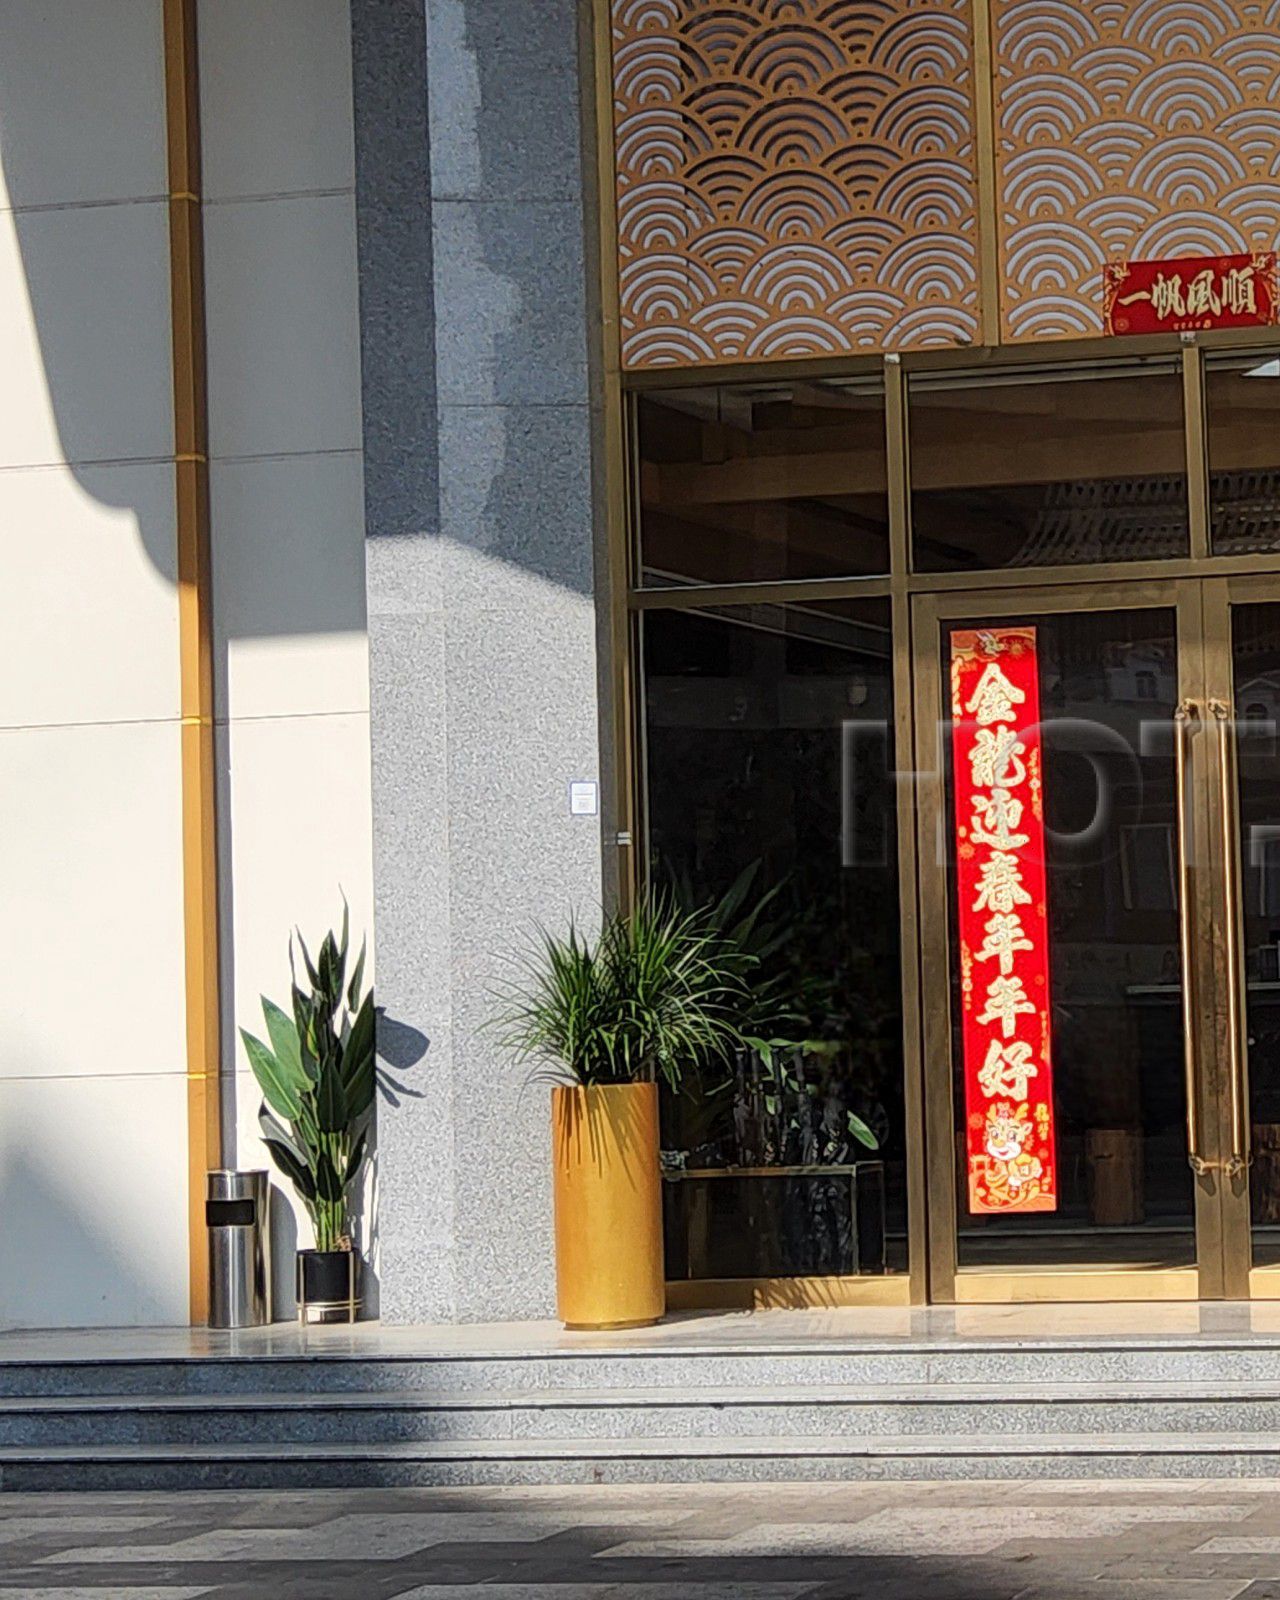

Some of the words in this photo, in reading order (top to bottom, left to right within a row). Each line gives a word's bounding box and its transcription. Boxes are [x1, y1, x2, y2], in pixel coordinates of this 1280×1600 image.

[965, 662, 1038, 1100] 金龍迎春年年好
